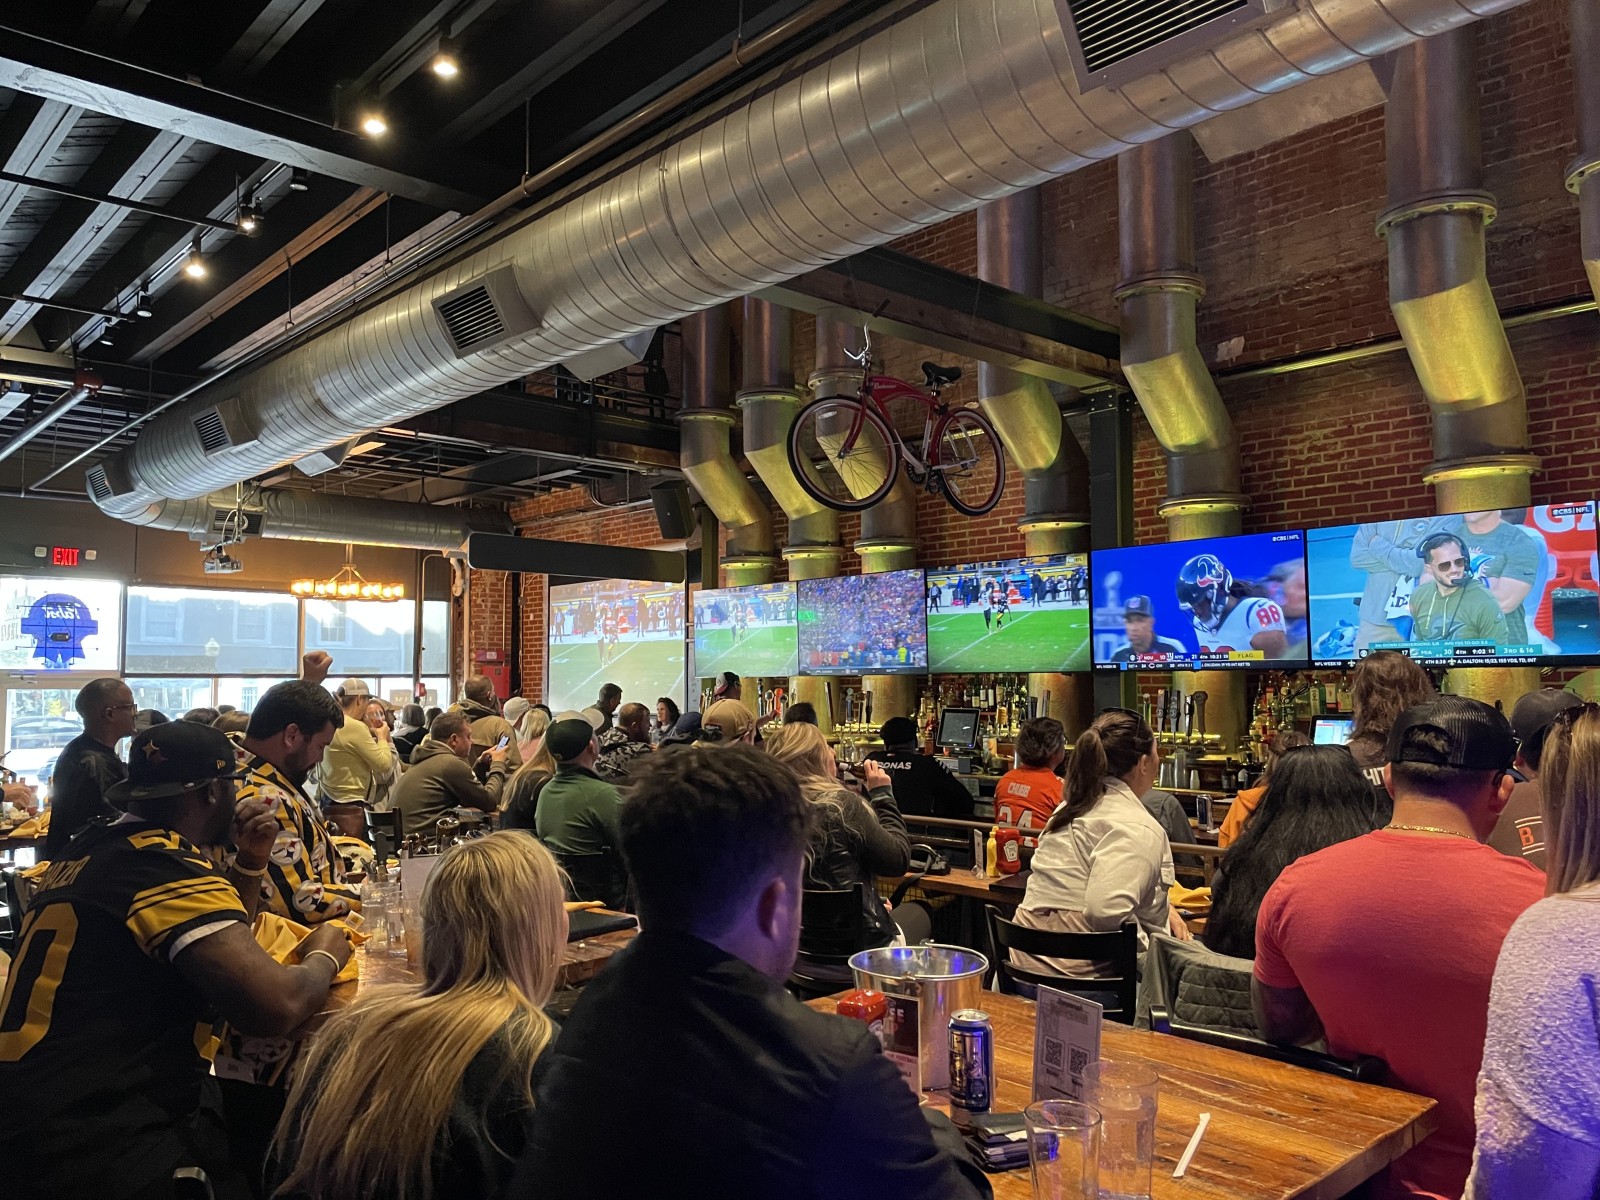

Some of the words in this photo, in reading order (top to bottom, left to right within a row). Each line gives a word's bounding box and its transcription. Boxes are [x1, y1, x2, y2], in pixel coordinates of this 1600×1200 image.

[1575, 506, 1590, 514] NFL
[53, 547, 79, 566] EXIT
[1256, 604, 1281, 628] 88
[877, 761, 912, 770] RONAS
[1363, 766, 1386, 786] HIT
[1007, 782, 1031, 797] CHUBB
[0, 902, 79, 1062] 0
